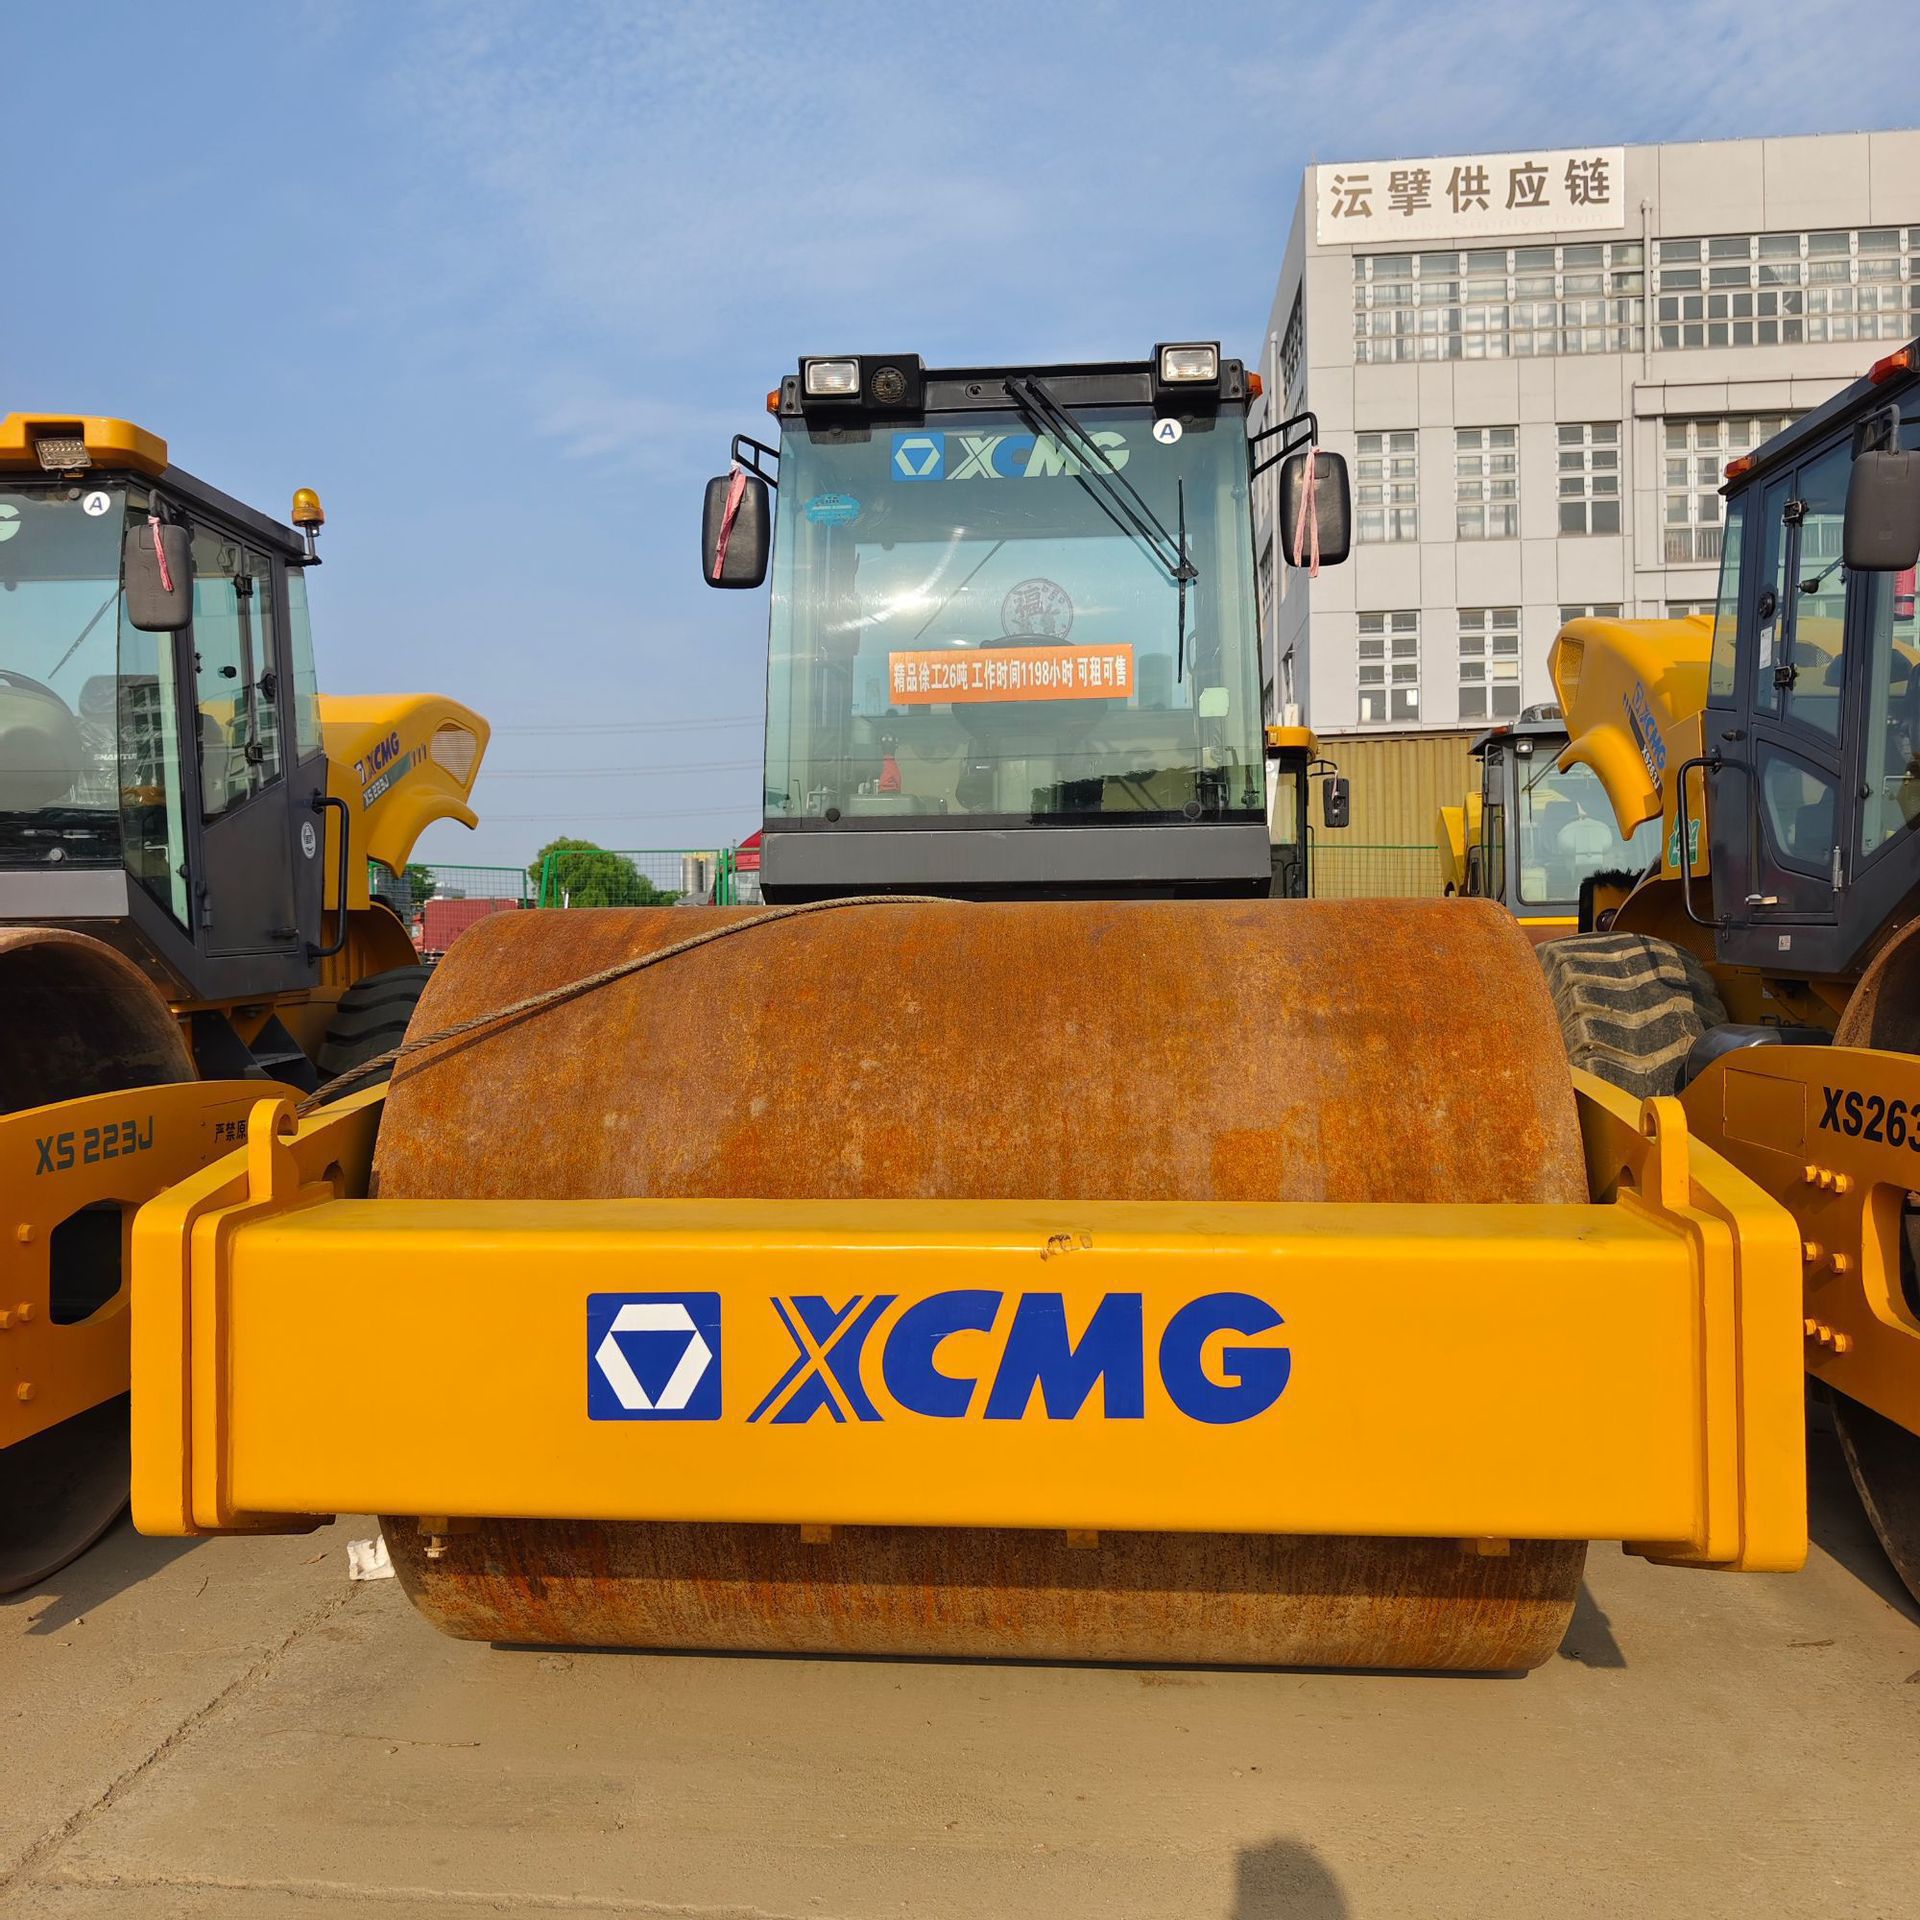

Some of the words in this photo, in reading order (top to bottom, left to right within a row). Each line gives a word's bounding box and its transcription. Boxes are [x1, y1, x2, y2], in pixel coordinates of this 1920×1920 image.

[1159, 423, 1177, 439] A
[946, 431, 1130, 480] XCMG
[88, 496, 104, 511] A
[894, 661, 969, 693] 精品徐工26吨
[972, 657, 1073, 691] 工作时间1198小时
[1077, 655, 1127, 688] 可租可售
[366, 731, 400, 781] XCMG
[1641, 744, 1660, 790] XS263J
[214, 1119, 247, 1143] 严禁原
[745, 1289, 1291, 1425] XCMG
